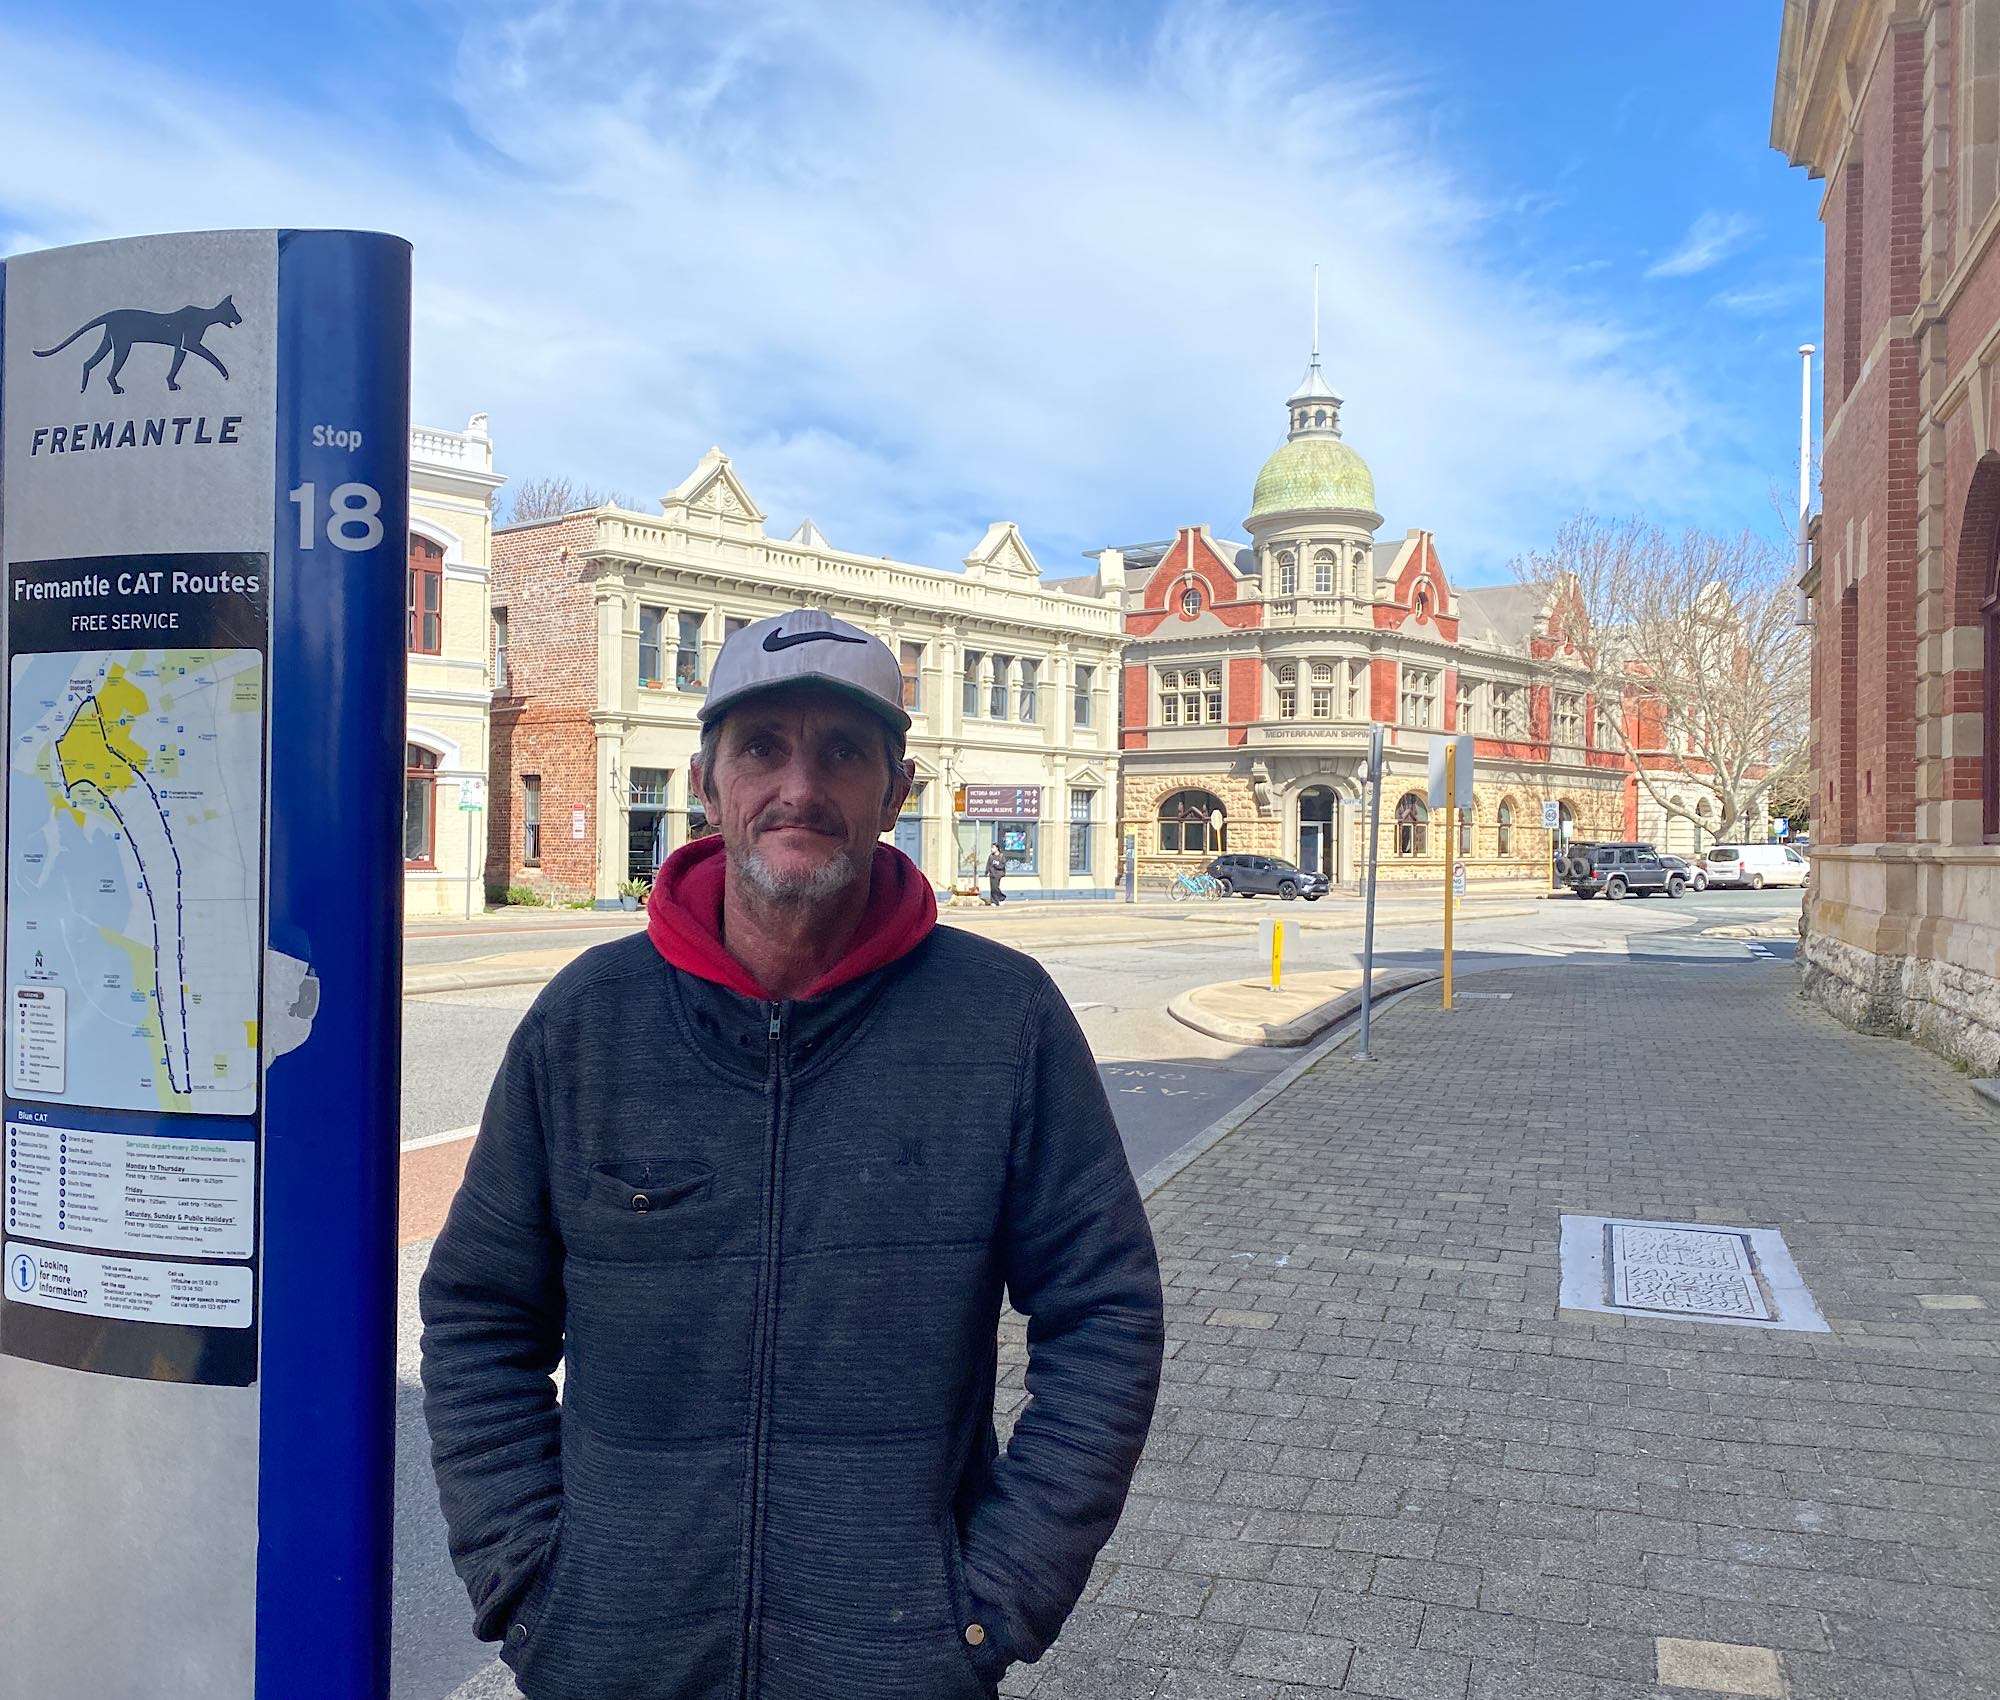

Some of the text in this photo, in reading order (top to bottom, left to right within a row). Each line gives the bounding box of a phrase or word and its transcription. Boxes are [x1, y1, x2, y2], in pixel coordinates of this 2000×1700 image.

[30, 416, 243, 456] FREMANTLE
[312, 425, 362, 453] Stop
[289, 483, 384, 551] 18
[14, 571, 259, 601] Fremantle CAT Routes
[71, 613, 179, 631] FREE SERVICE
[1266, 730, 1369, 738] MEDITERRANEAN SHIPPIN
[18, 1111, 47, 1122] Blue CAT
[157, 1165, 185, 1173] Thursday
[39, 1258, 68, 1272] Looking
[39, 1272, 70, 1283] for more
